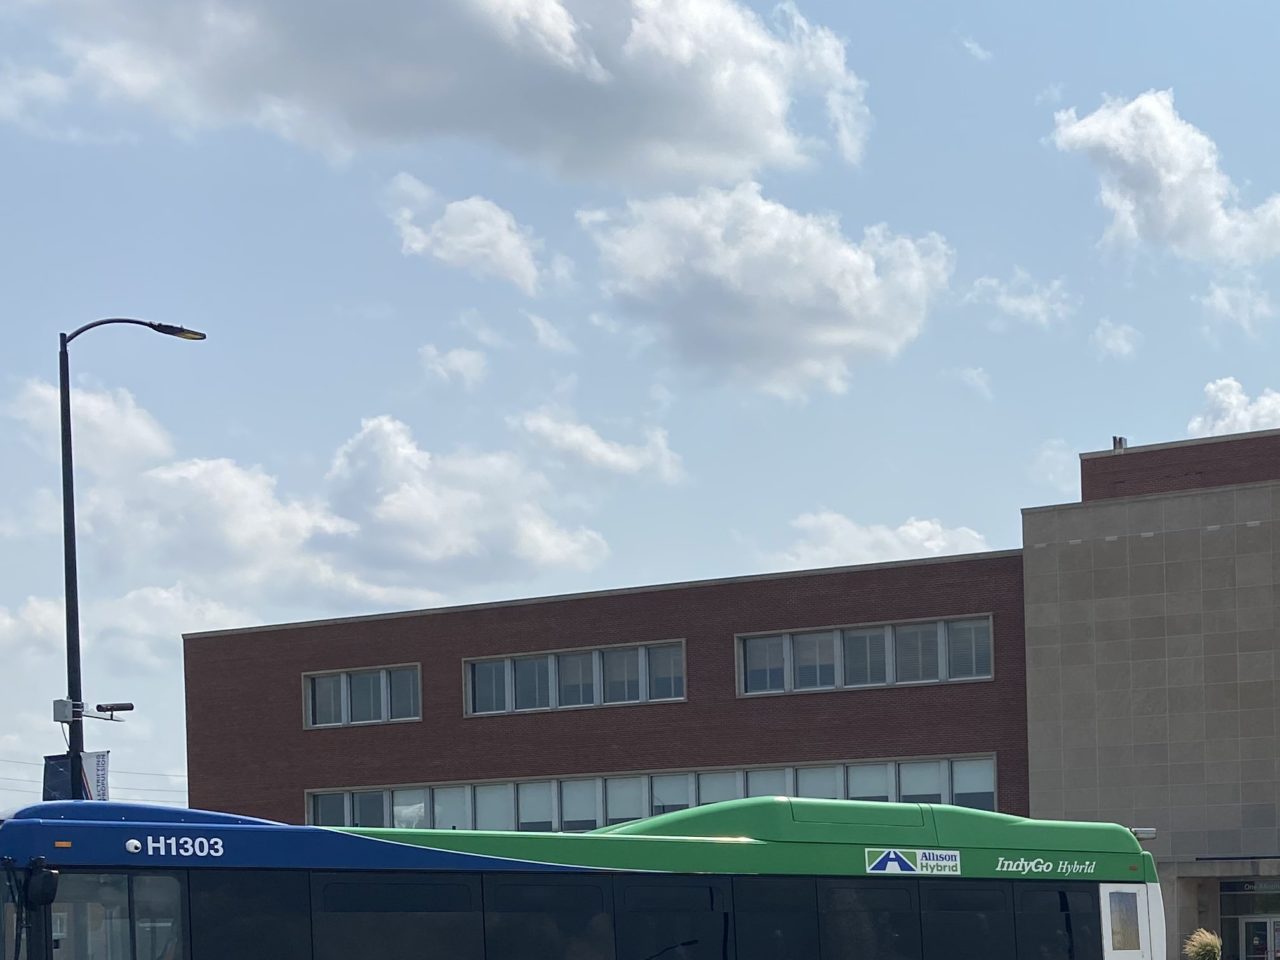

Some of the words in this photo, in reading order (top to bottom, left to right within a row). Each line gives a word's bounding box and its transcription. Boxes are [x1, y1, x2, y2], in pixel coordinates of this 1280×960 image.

[147, 836, 224, 857] H1303
[920, 851, 958, 862] Allison
[920, 862, 958, 874] Hybrid
[995, 857, 1054, 874] IndyGo
[1057, 861, 1097, 876] Hybrid
